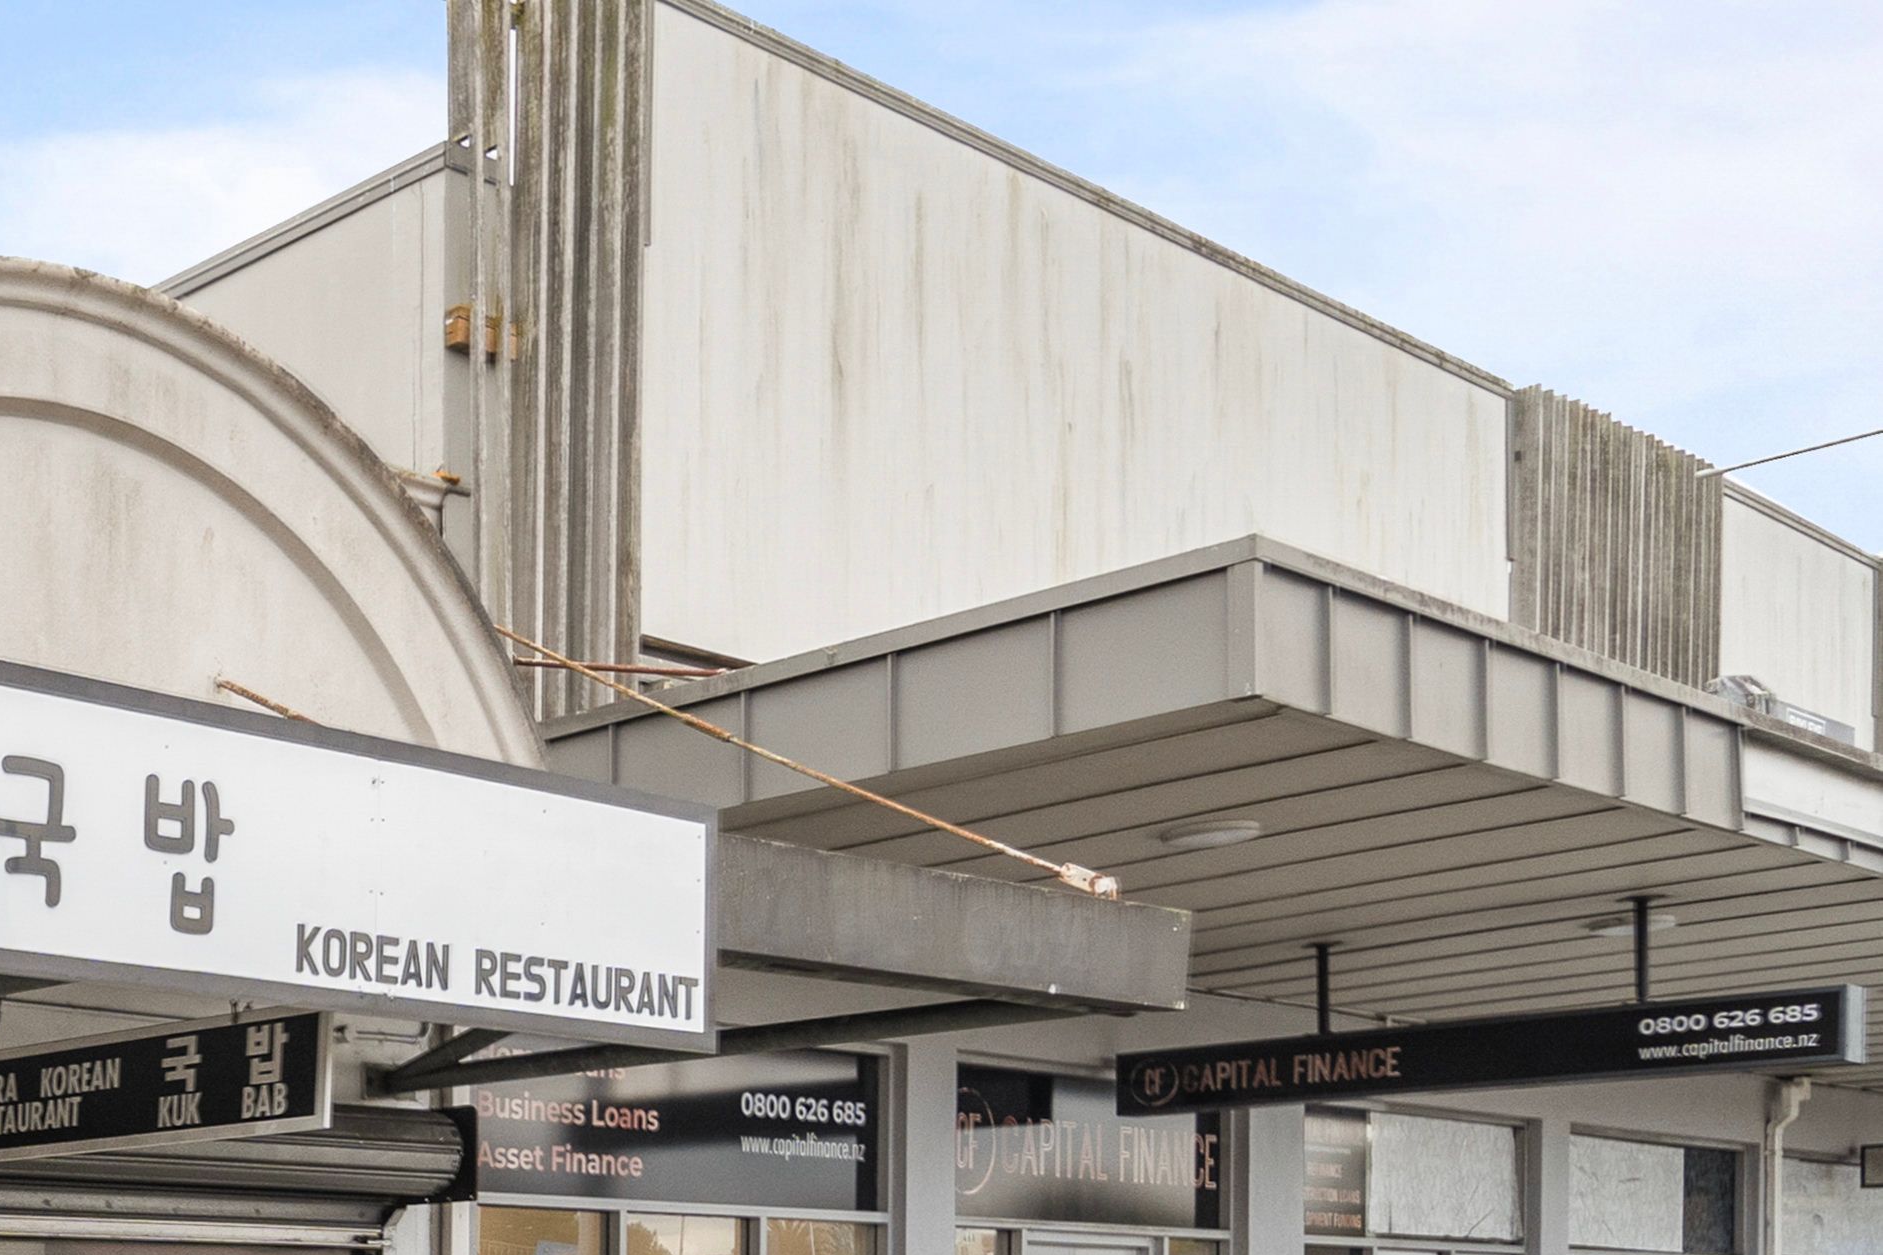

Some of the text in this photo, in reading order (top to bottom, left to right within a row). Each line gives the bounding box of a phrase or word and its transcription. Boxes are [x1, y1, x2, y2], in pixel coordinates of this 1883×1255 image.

[144, 773, 235, 935] 밥
[295, 923, 699, 1021] KOREAN RESTAURANT
[1638, 1003, 1821, 1035] 0800 626 685
[161, 1022, 290, 1091] 국 밥
[1638, 1033, 1820, 1060] www.capitalfinance.nz
[40, 1057, 122, 1099] KOREAN
[1182, 1057, 1282, 1093] CAPITAL
[1293, 1046, 1402, 1085] FINANCE
[157, 1082, 290, 1128] KUK BAB
[478, 1089, 660, 1133] Business Loans
[740, 1092, 867, 1126] 0800 626 685
[478, 1143, 644, 1178] Asset Finance
[740, 1132, 867, 1162] www.capitalfinance.nz
[1001, 1115, 1108, 1181] CAPITAL
[1119, 1126, 1218, 1191] FINANCE
